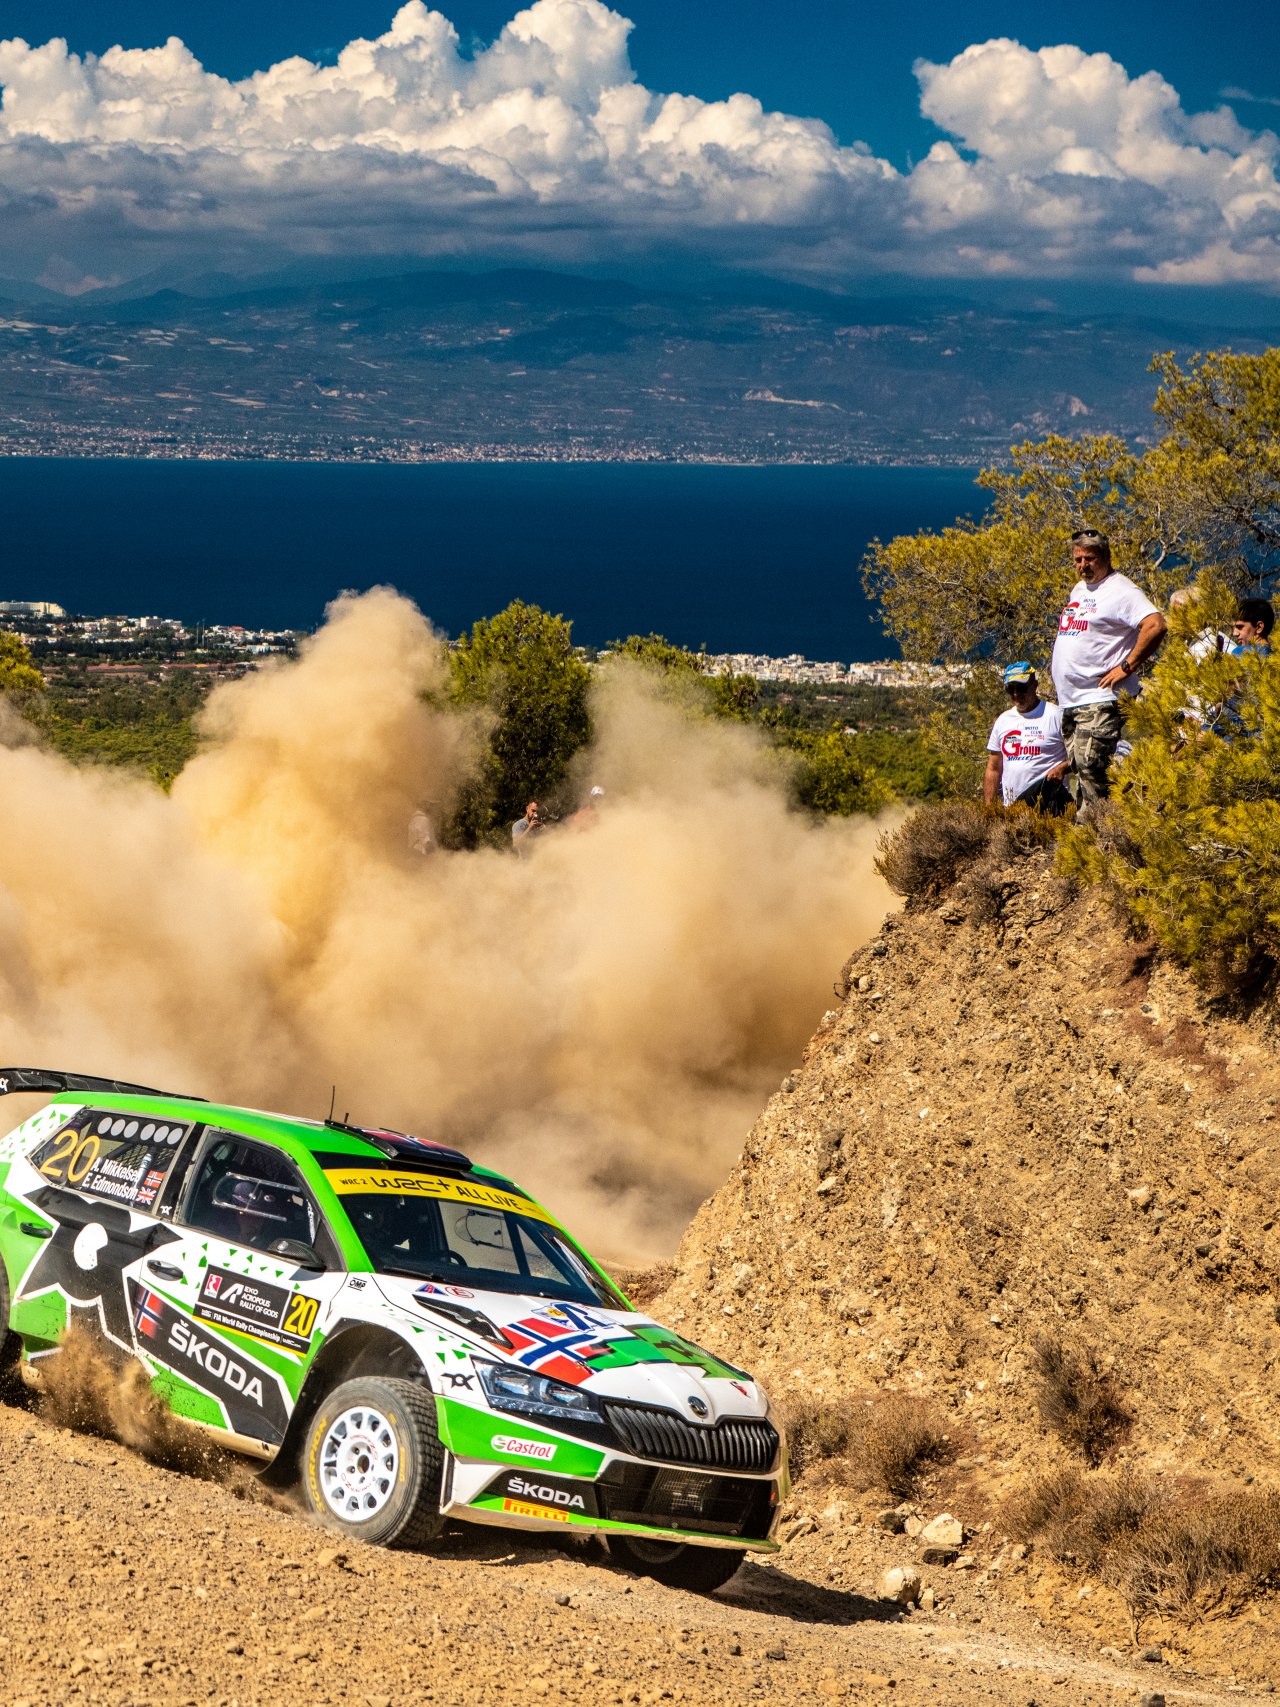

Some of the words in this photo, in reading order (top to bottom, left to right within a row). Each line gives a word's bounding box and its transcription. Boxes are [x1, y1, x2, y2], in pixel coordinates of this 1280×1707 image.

[39, 1129, 101, 1183] 20
[90, 1156, 102, 1172] A.
[81, 1172, 91, 1187] E.
[91, 1176, 139, 1201] Edmondson
[339, 1178, 360, 1186] WRC
[361, 1178, 367, 1186] 2
[456, 1185, 487, 1202] ALL
[487, 1192, 523, 1211] LIVE
[349, 1279, 367, 1289] OMP
[239, 1300, 256, 1311] RALLY
[255, 1305, 264, 1313] OF
[263, 1307, 279, 1319] GODS
[241, 1292, 272, 1308] ACROPOLIS
[212, 1312, 222, 1322] FIA
[222, 1315, 236, 1327] World
[235, 1320, 248, 1332] Rally
[248, 1324, 281, 1342] Championship
[283, 1294, 318, 1337] 20
[168, 1319, 264, 1408] ŠKODA
[506, 1439, 552, 1458] Castrol
[309, 1417, 328, 1513] SCORPION
[507, 1476, 585, 1509] ŠKODA
[503, 1497, 569, 1523] PIRELLI
